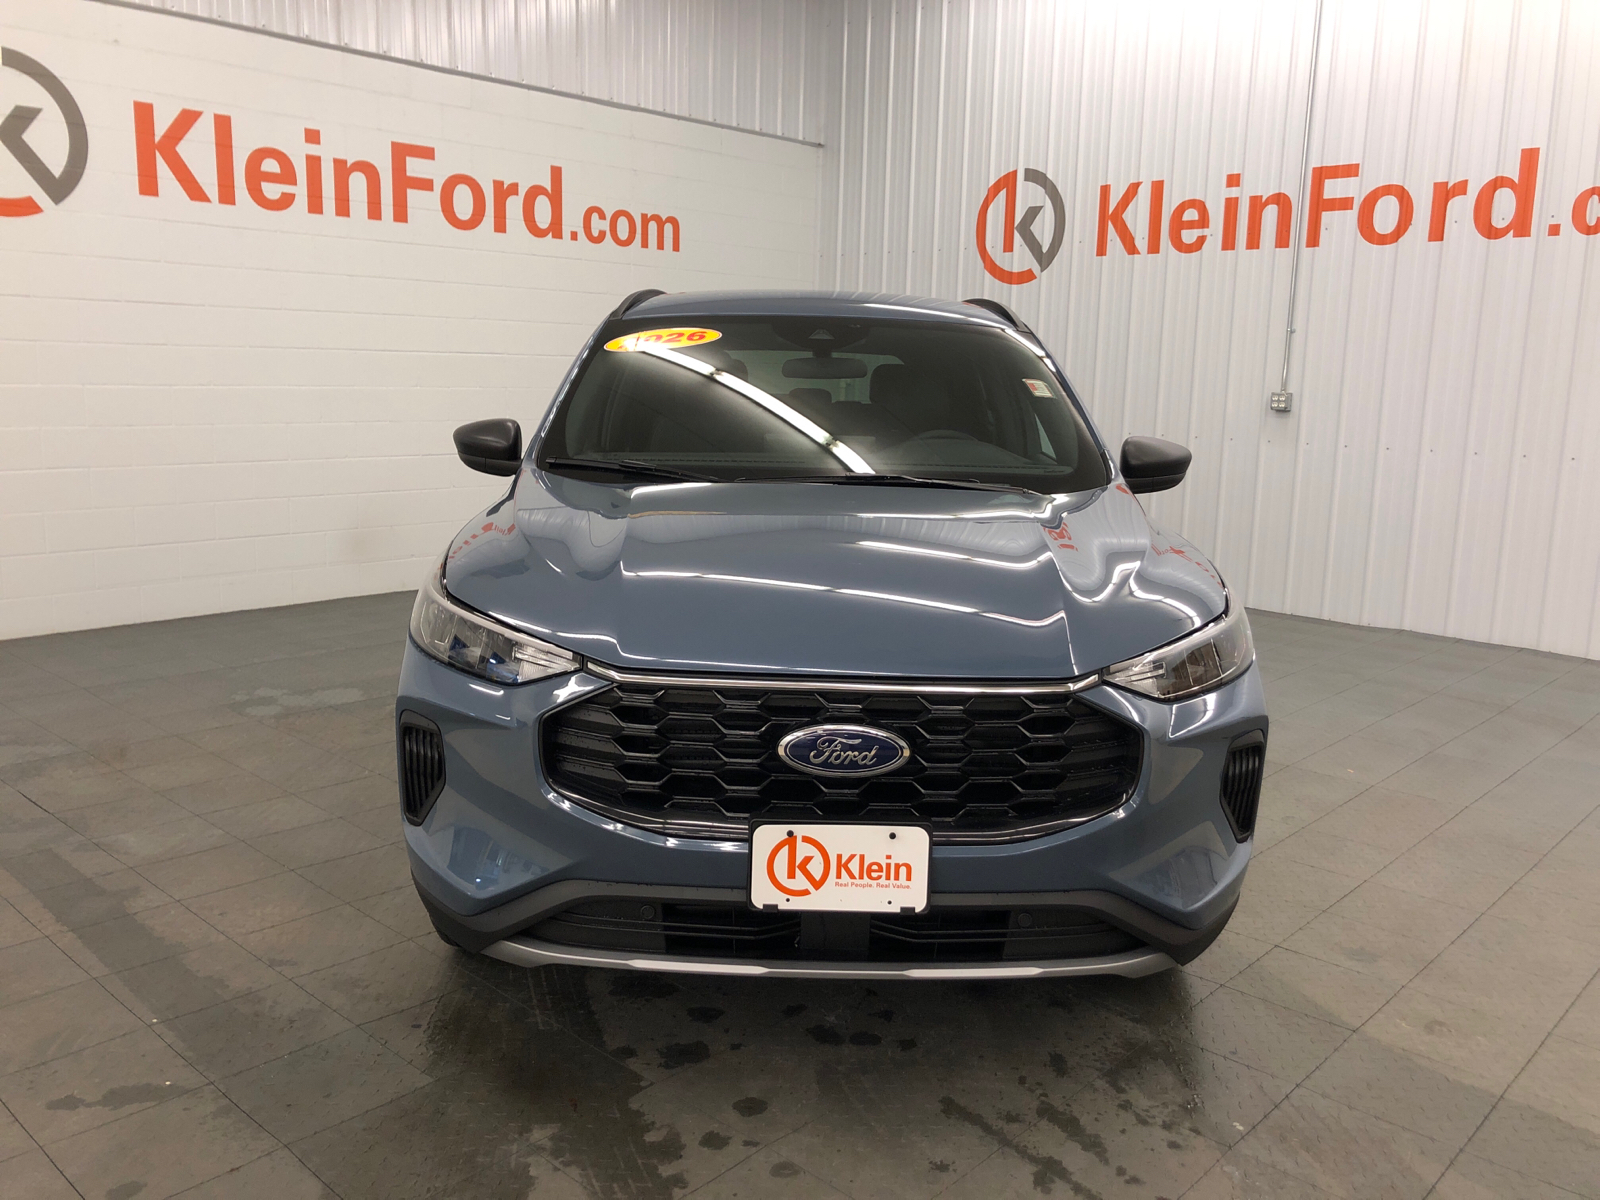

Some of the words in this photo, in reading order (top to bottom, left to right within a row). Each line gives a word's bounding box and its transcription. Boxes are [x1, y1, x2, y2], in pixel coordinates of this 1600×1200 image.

[133, 99, 681, 253] KleinFord.com
[617, 330, 708, 350] 026
[809, 735, 880, 767] Ford
[835, 853, 913, 882] Klein
[850, 881, 875, 889] People.
[892, 882, 912, 890] Value.
